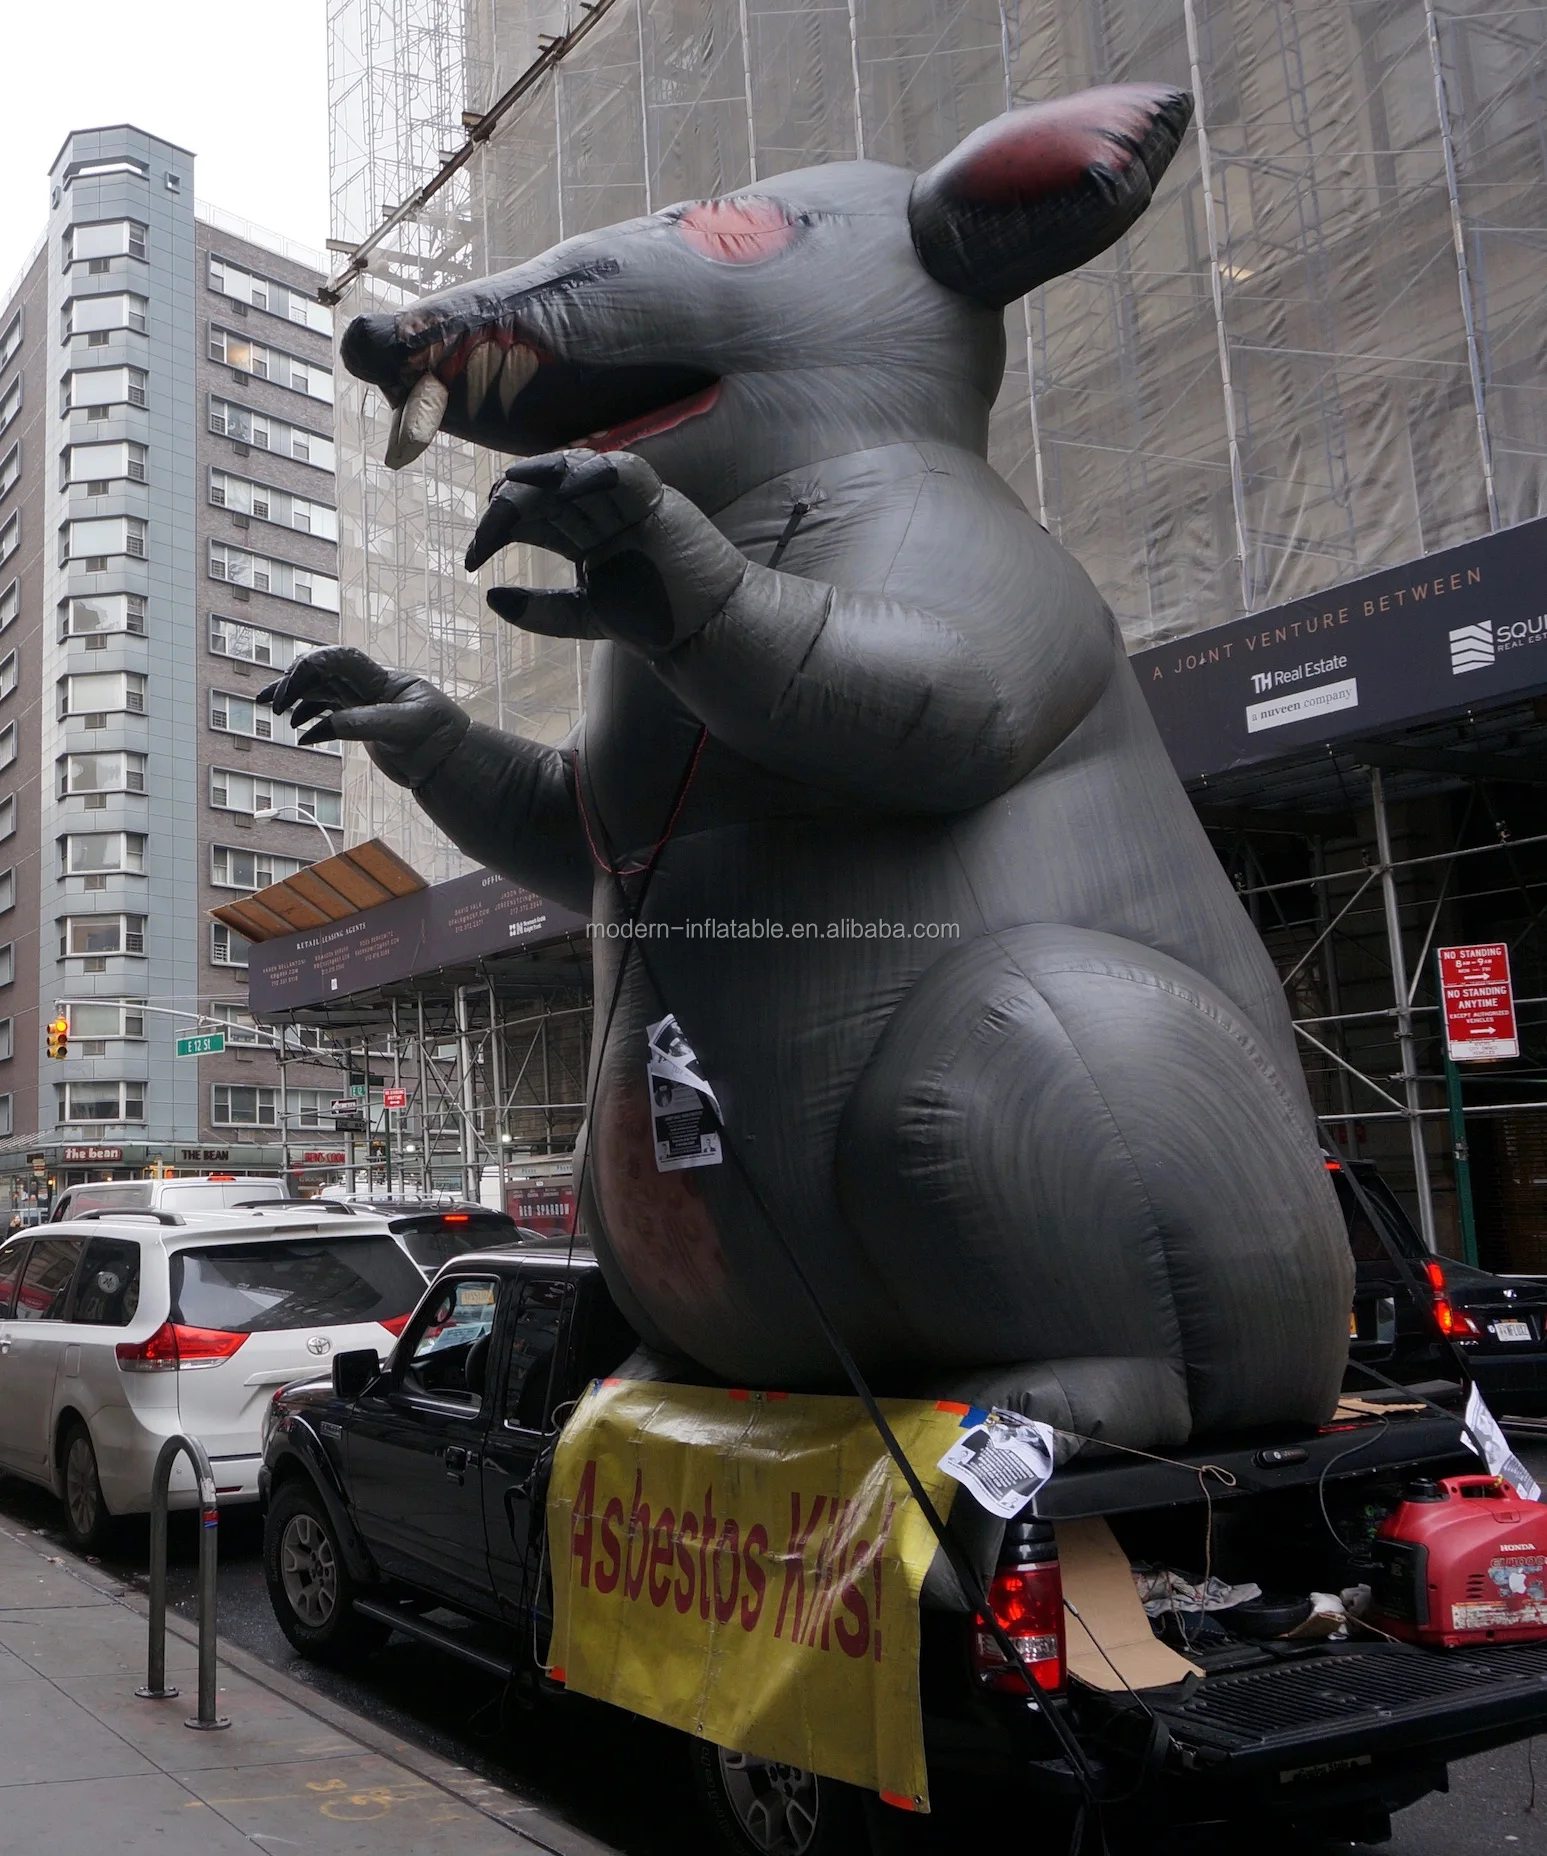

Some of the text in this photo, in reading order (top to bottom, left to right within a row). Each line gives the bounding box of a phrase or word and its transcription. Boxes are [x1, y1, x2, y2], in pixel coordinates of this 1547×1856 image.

[1153, 566, 1482, 681] A JOINT VENTURE BETWEEN
[1497, 640, 1524, 652] REAL
[1250, 655, 1348, 694] TH Real Estate
[1251, 688, 1353, 722] a nuveen company
[481, 874, 503, 887] OFFIC
[296, 922, 366, 950] RETAIL LEASING AGENTS
[1443, 947, 1502, 960] NO STANDING
[1447, 986, 1507, 998] NO STANDING
[1458, 998, 1498, 1009] ANYTIME
[1449, 1009, 1509, 1020] EXCEPT AUTHORIZED
[187, 1038, 211, 1053] E 12 St
[65, 1147, 119, 1159] the bean
[181, 1150, 229, 1160] THE BEAN
[1499, 1543, 1536, 1552] HONDA
[571, 1459, 769, 1632] Asbestos
[773, 1491, 896, 1663] Kills!
